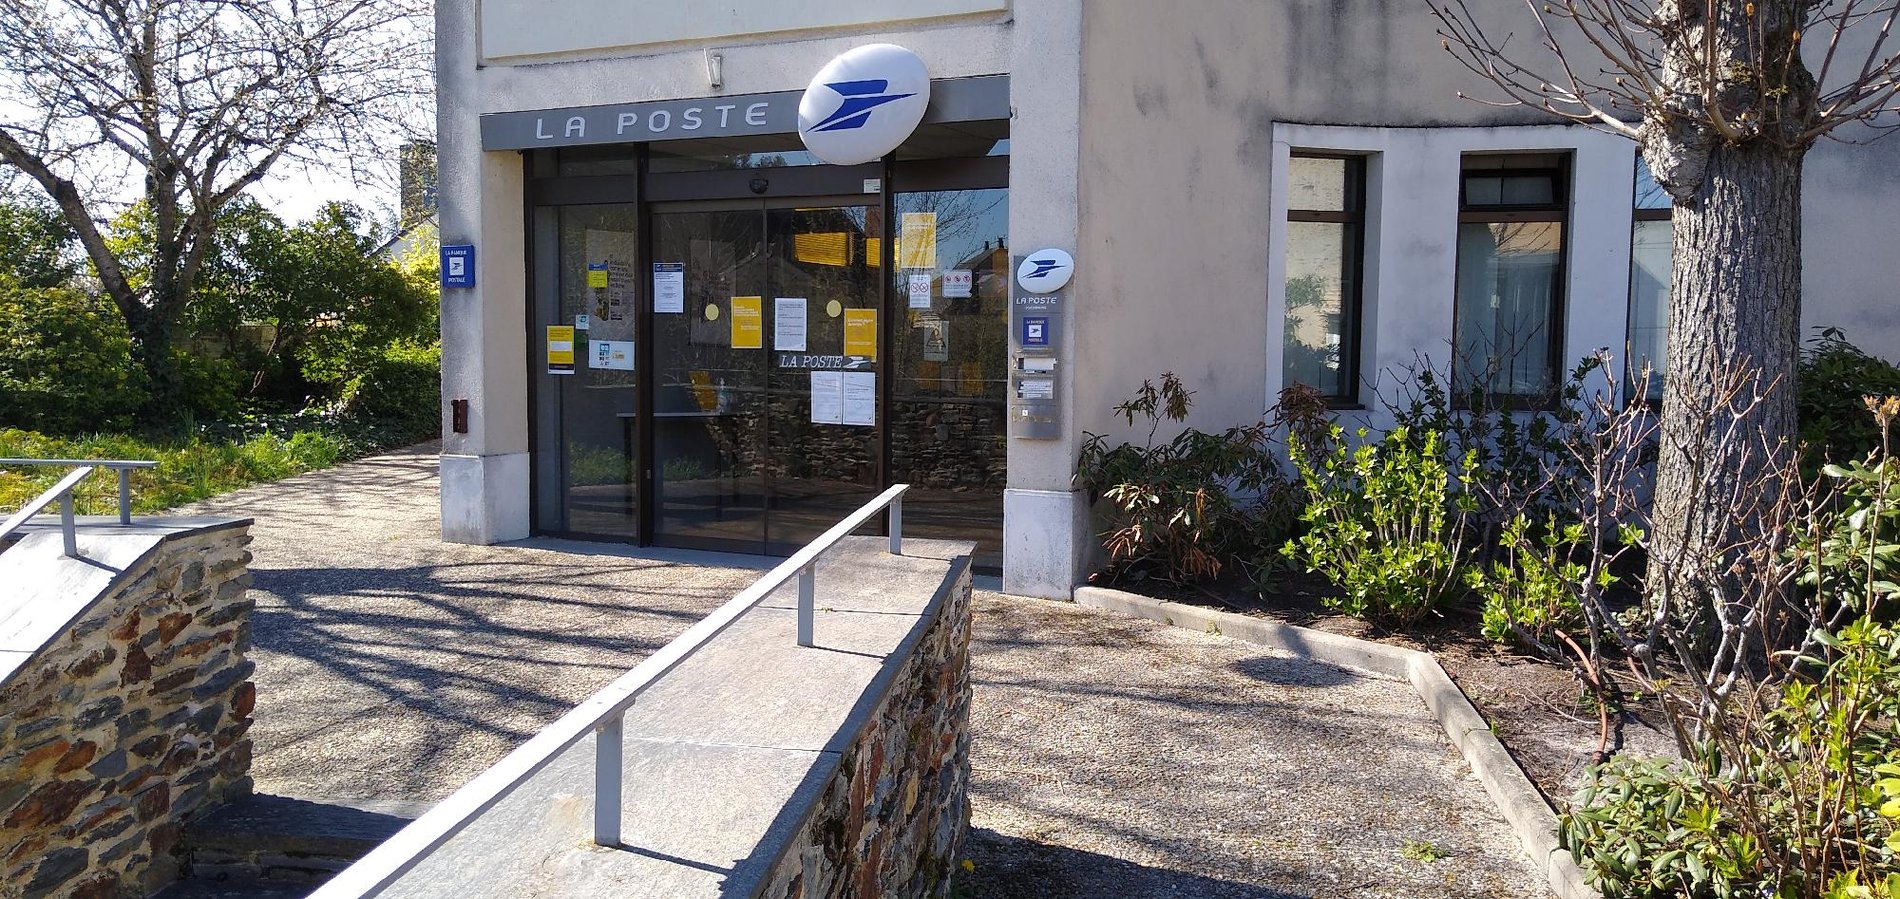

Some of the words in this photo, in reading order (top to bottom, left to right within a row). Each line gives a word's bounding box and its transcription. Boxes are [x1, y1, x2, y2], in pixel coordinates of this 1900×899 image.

[536, 116, 586, 140] LA
[616, 103, 769, 135] POSTE
[1016, 297, 1027, 305] LA
[779, 355, 798, 368] LA
[801, 355, 844, 368] POSTE
